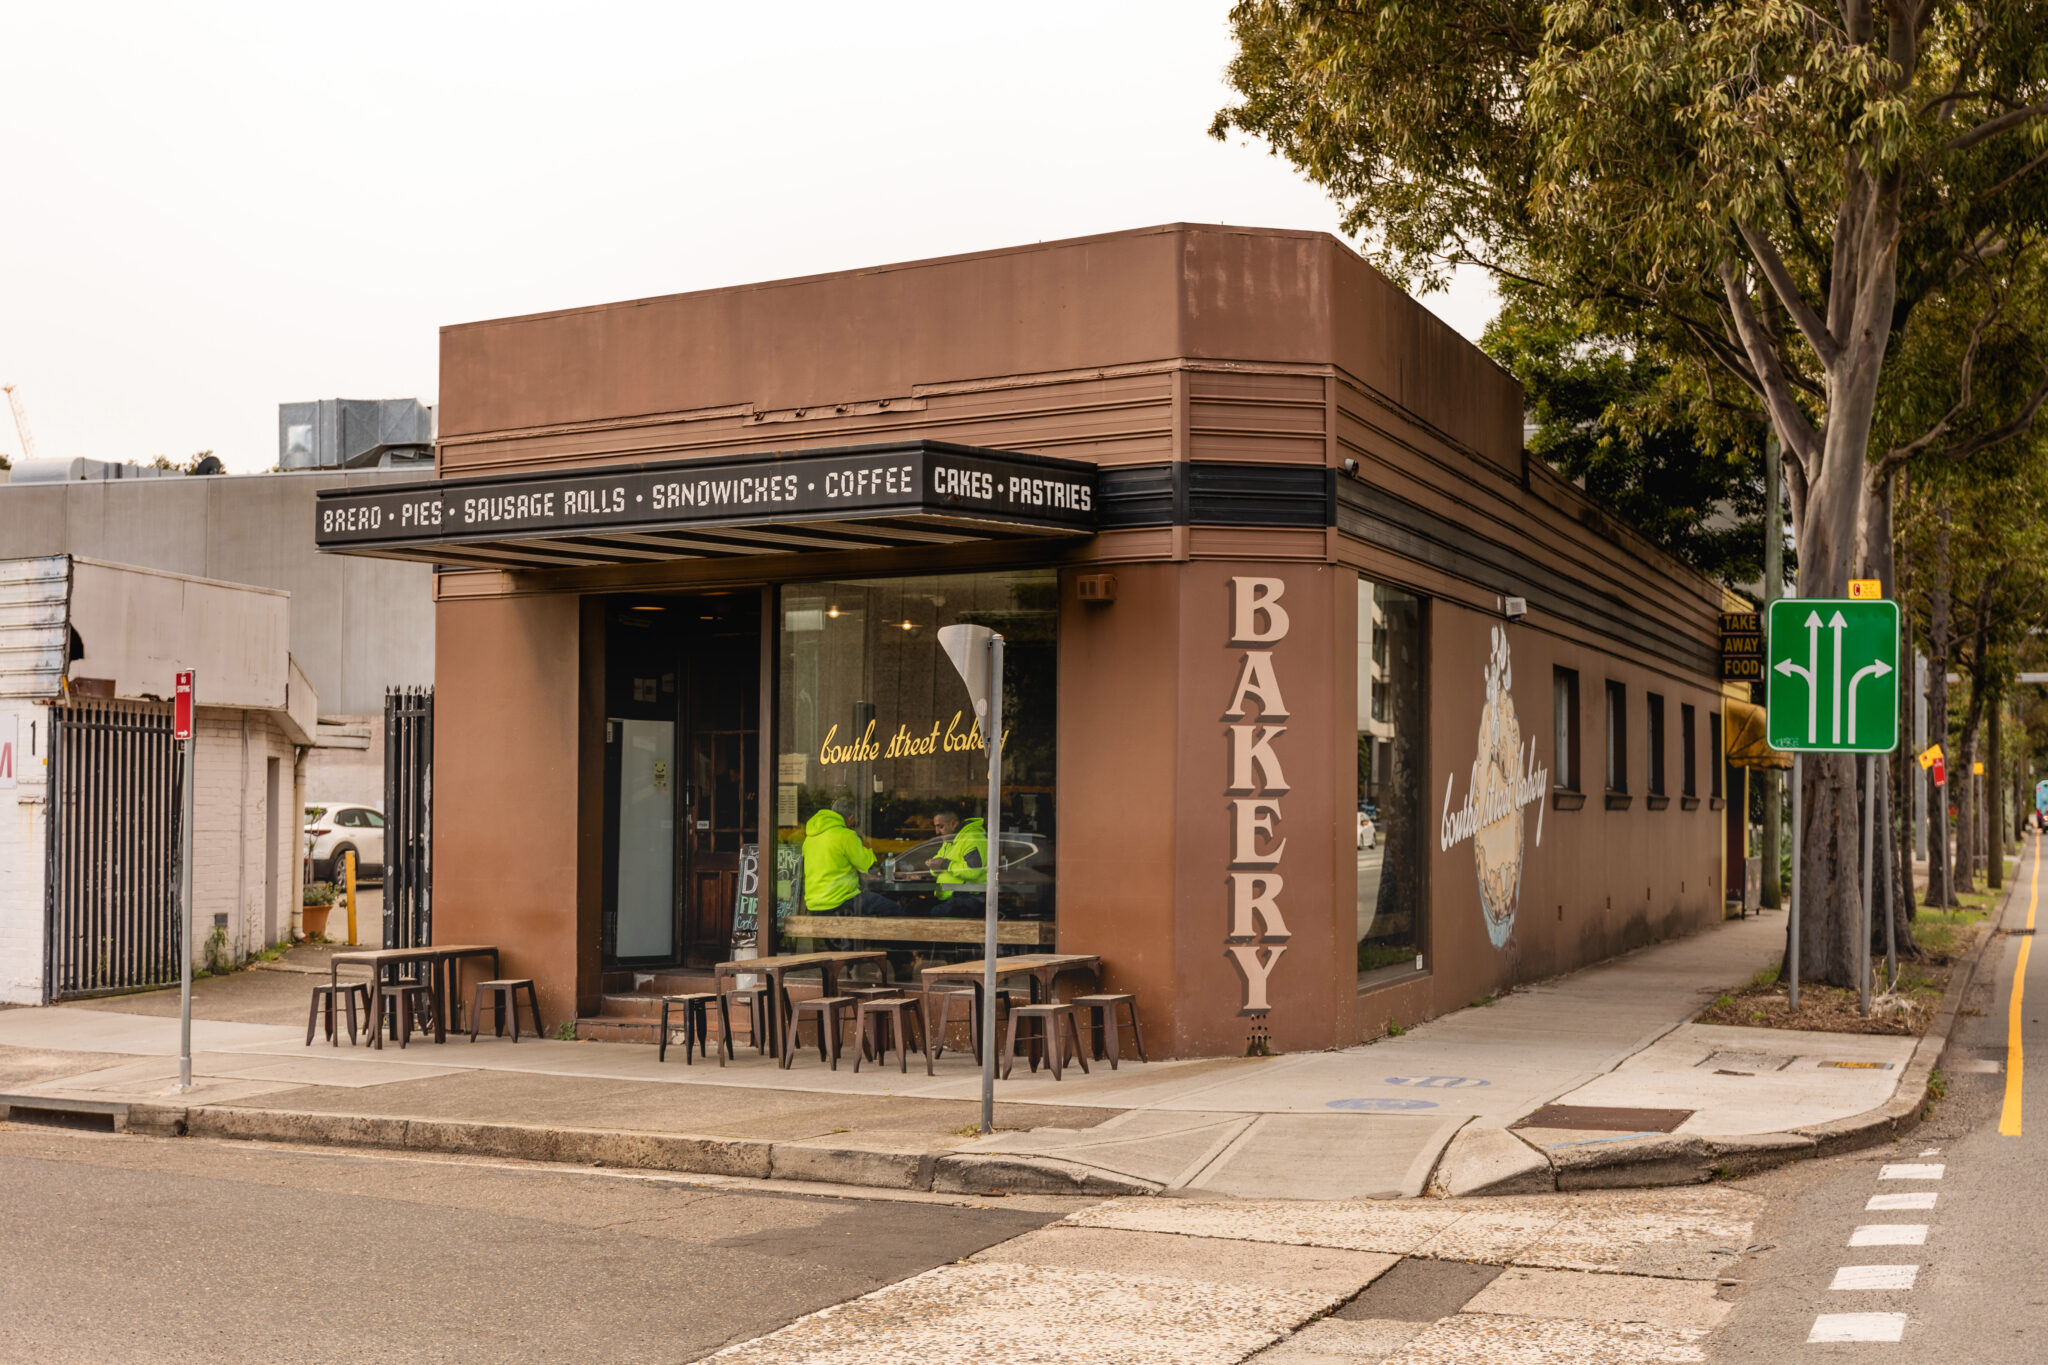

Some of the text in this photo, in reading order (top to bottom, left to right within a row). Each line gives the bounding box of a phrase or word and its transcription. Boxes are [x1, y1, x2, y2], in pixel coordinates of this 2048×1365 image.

[323, 465, 913, 533] BREAD PIES SAUSAGE ROLLS SANDWICHES COFFEE
[934, 466, 1092, 512] CAKES PASTRIES
[1723, 615, 1757, 631] TAKE
[1723, 637, 1759, 653] AWAY
[1724, 659, 1759, 675] FOOD
[30, 720, 36, 756] 1
[819, 718, 880, 766] bourke
[884, 720, 941, 760] street
[1222, 575, 1292, 1013] BAKERY
